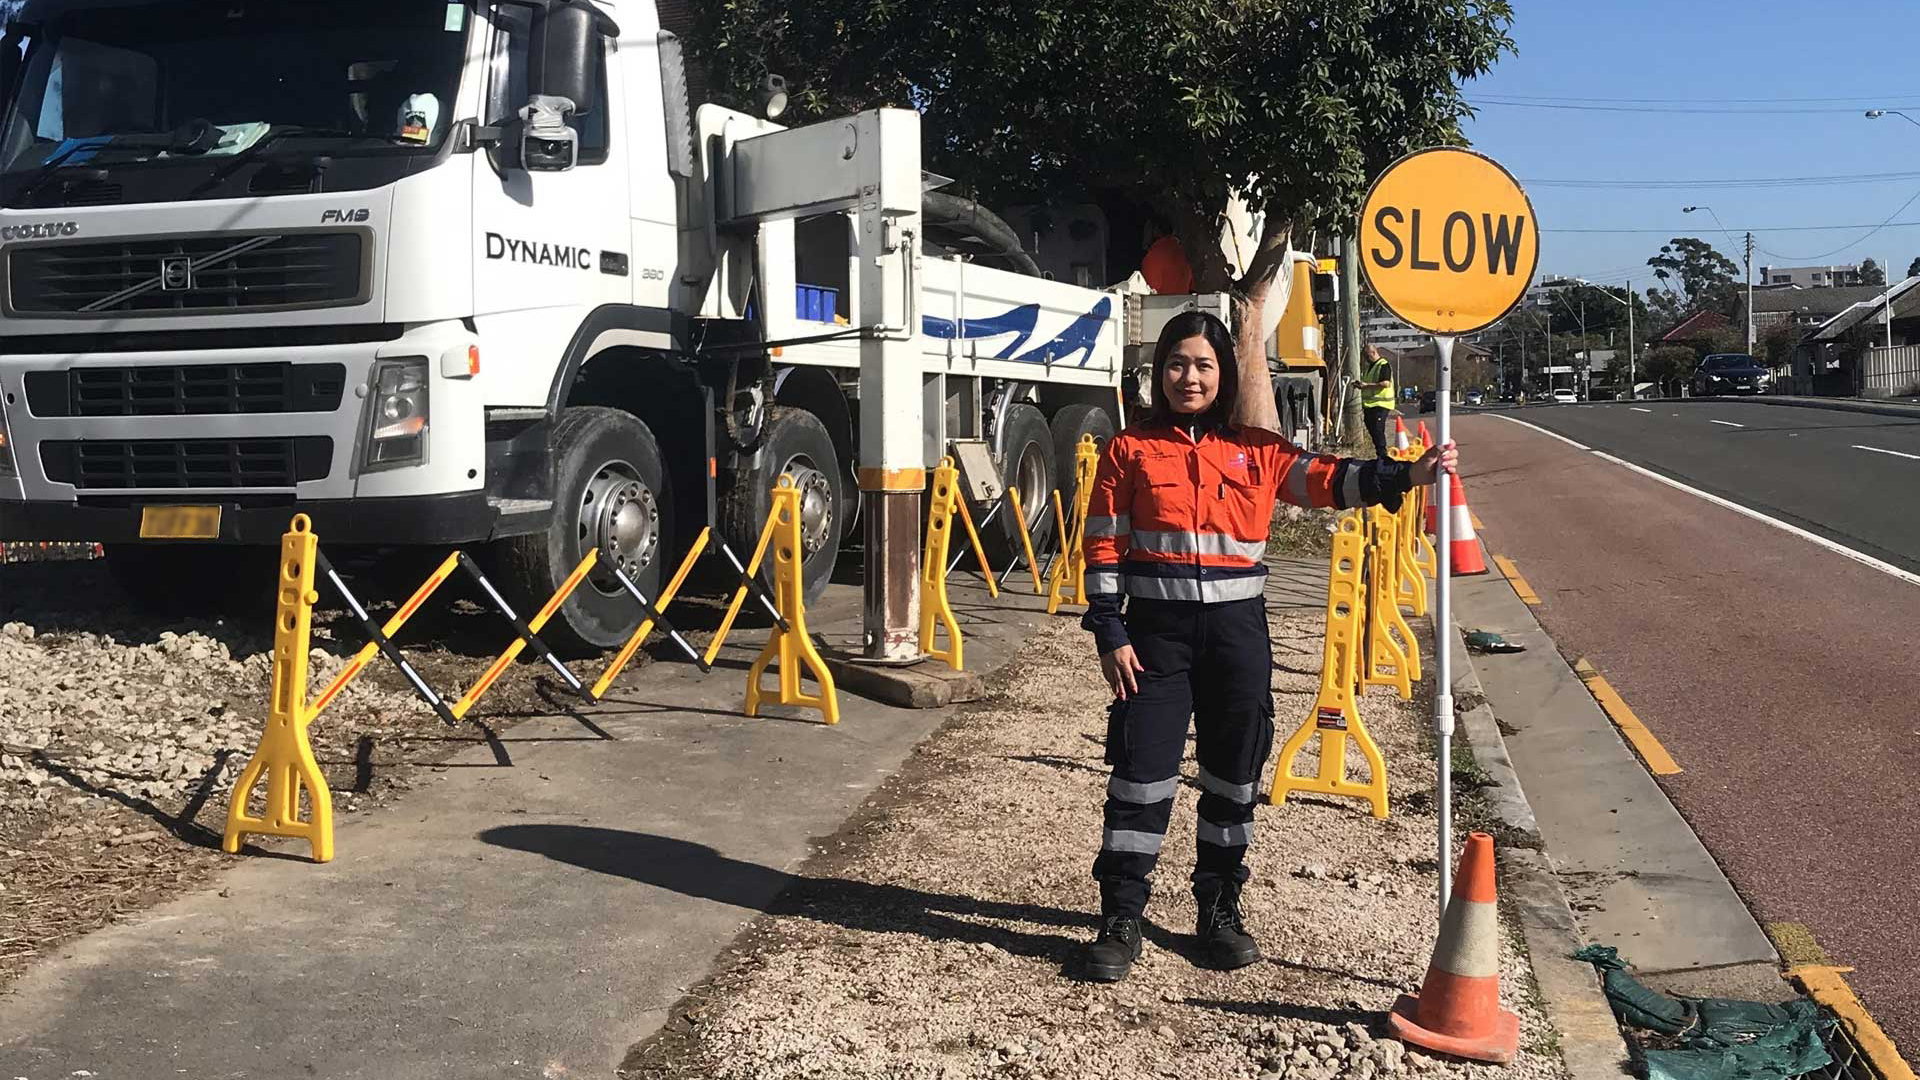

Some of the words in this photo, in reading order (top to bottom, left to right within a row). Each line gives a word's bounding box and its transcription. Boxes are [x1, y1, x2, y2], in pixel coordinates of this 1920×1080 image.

[1, 221, 79, 241] VOLVO
[485, 231, 591, 270] DYNAMIC
[1371, 206, 1525, 276] SLOW
